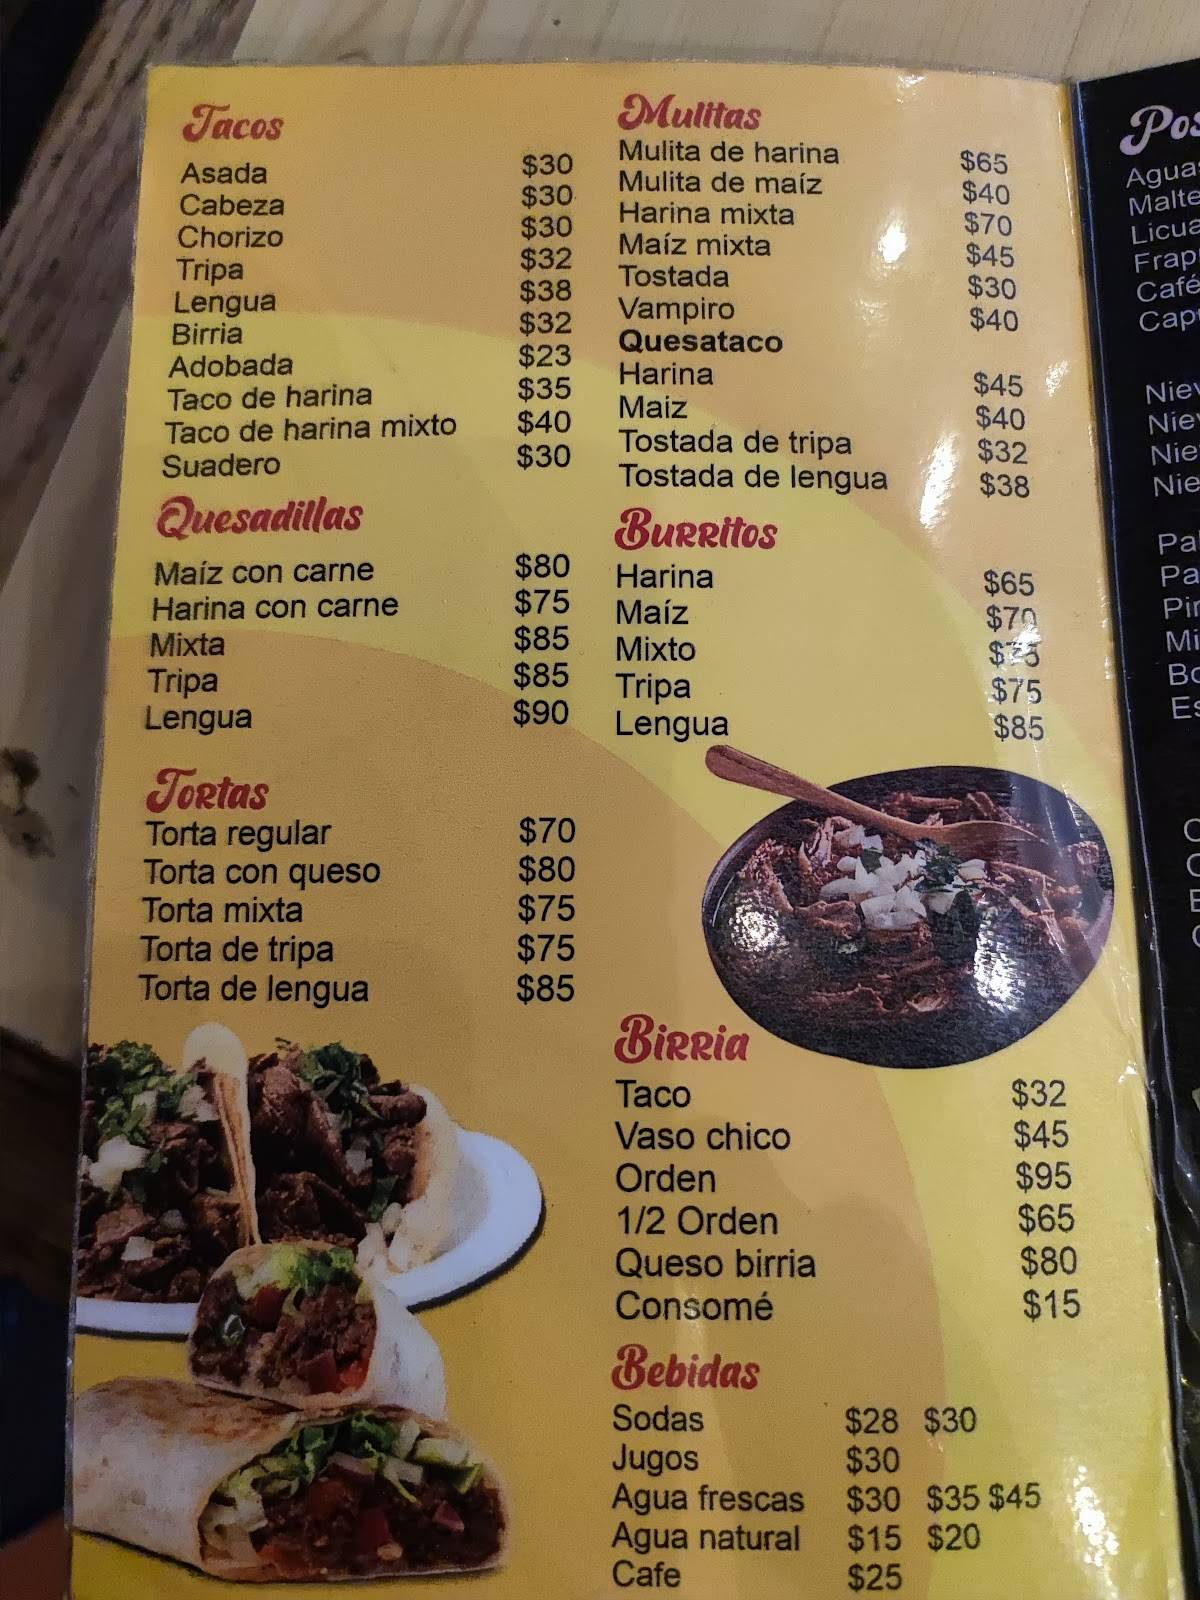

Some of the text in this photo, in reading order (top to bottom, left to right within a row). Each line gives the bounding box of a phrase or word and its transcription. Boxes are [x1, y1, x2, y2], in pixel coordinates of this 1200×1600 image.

[182, 104, 284, 143] Tacos
[617, 93, 761, 130] Mulitas
[181, 153, 573, 184] Asada $30
[619, 139, 1008, 175] Mulita de harina $65
[619, 170, 1010, 205] Mulita de maíz $40
[1126, 161, 1200, 189] Agua
[180, 184, 573, 216] Cabeza $30
[177, 215, 572, 248] Chorizo $30
[620, 202, 1012, 236] Harina mixta $70
[176, 246, 572, 286] Tripa $32
[619, 232, 1014, 268] Maíz mixta $45
[175, 279, 571, 318] Lengua $38
[618, 264, 1016, 300] Tostada $30
[172, 311, 572, 345] Birria $32
[618, 296, 1018, 332] Vampiro $40
[619, 329, 783, 353] Quesataco
[168, 343, 571, 378] Adobada $23
[167, 377, 571, 411] Taco de harina $35
[620, 362, 1023, 397] Harina $45
[164, 410, 571, 444] Taco de harina mixto $40
[620, 395, 1025, 431] Maiz $40
[162, 443, 571, 478] Suadero $30
[618, 429, 1028, 464] Tostada de tripa $32
[618, 463, 1029, 498] Tostada de lengua $38
[156, 496, 364, 541] Quesadillas
[614, 507, 778, 550] Burritos
[154, 552, 570, 586] Maíz con carne $80
[617, 563, 1034, 597] Harina $65
[153, 588, 569, 621] Harina con carne $75
[617, 599, 1037, 632] Maíz $70
[149, 624, 569, 658] Mixta $85
[617, 636, 696, 661] Mixto
[147, 661, 569, 699] Tripa $85
[615, 673, 1041, 705] Tripa $75
[145, 698, 569, 736] Lengua $90
[617, 710, 1044, 742] Lengua $85
[146, 768, 269, 813] Tortas
[145, 816, 575, 852] Torta regular $70
[143, 855, 575, 891] Torta con queso $80
[141, 894, 575, 925] Torta mixta $75
[139, 933, 575, 969] Torta de tripa $75
[138, 973, 574, 1009] Torta de lengua $85
[614, 1014, 749, 1064] Birria
[615, 1078, 1066, 1110] Taco $32
[615, 1119, 1069, 1152] Vaso chico $45
[616, 1161, 1072, 1194] Orden $95
[618, 1203, 1075, 1237] 1/2 Orden $65
[616, 1246, 1077, 1279] Queso birria $80
[616, 1288, 1081, 1323] Consomé $15
[611, 1344, 760, 1390] Bebidas
[613, 1404, 977, 1437] Sodas $28 $30
[612, 1443, 900, 1477] Jugos $30
[612, 1482, 1041, 1516] Agua frescas $30 $35 $45
[611, 1521, 981, 1555] Agua natural $15 $20
[613, 1560, 902, 1593] Cafe $25
